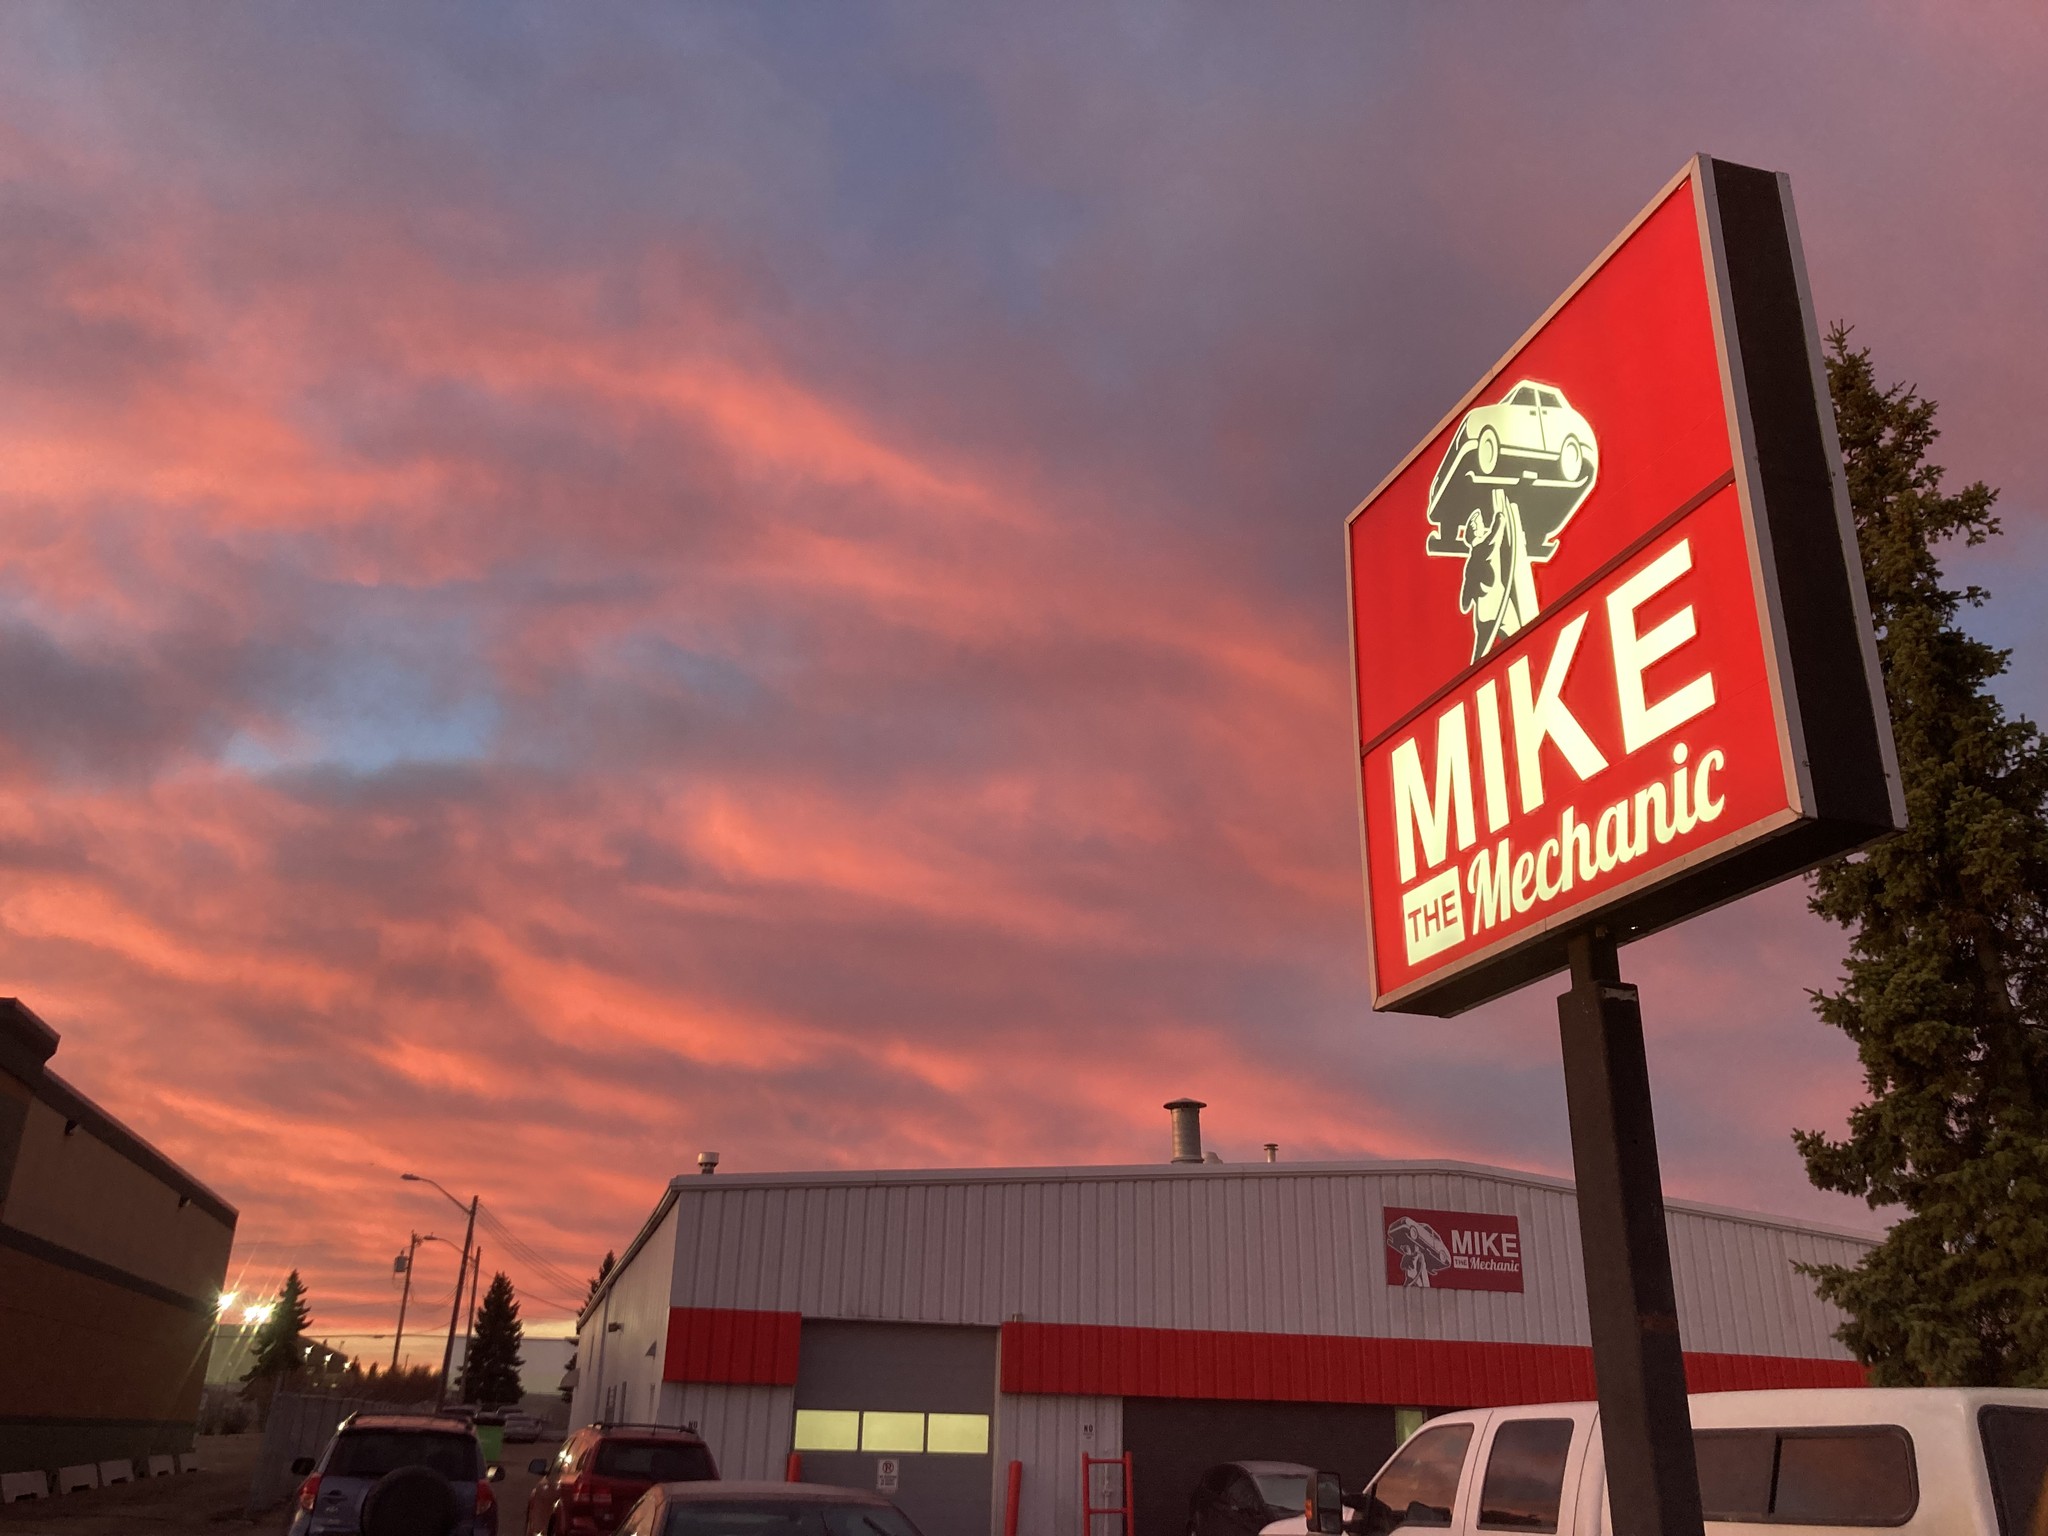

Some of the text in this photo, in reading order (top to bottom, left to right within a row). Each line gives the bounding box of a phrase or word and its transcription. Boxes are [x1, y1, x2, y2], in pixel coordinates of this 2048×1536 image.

[1391, 537, 1717, 886] MIKE
[1407, 742, 1726, 944] THE Mechanic
[1451, 1229, 1519, 1258] MIKE
[1455, 1256, 1520, 1272] THE Mechanic
